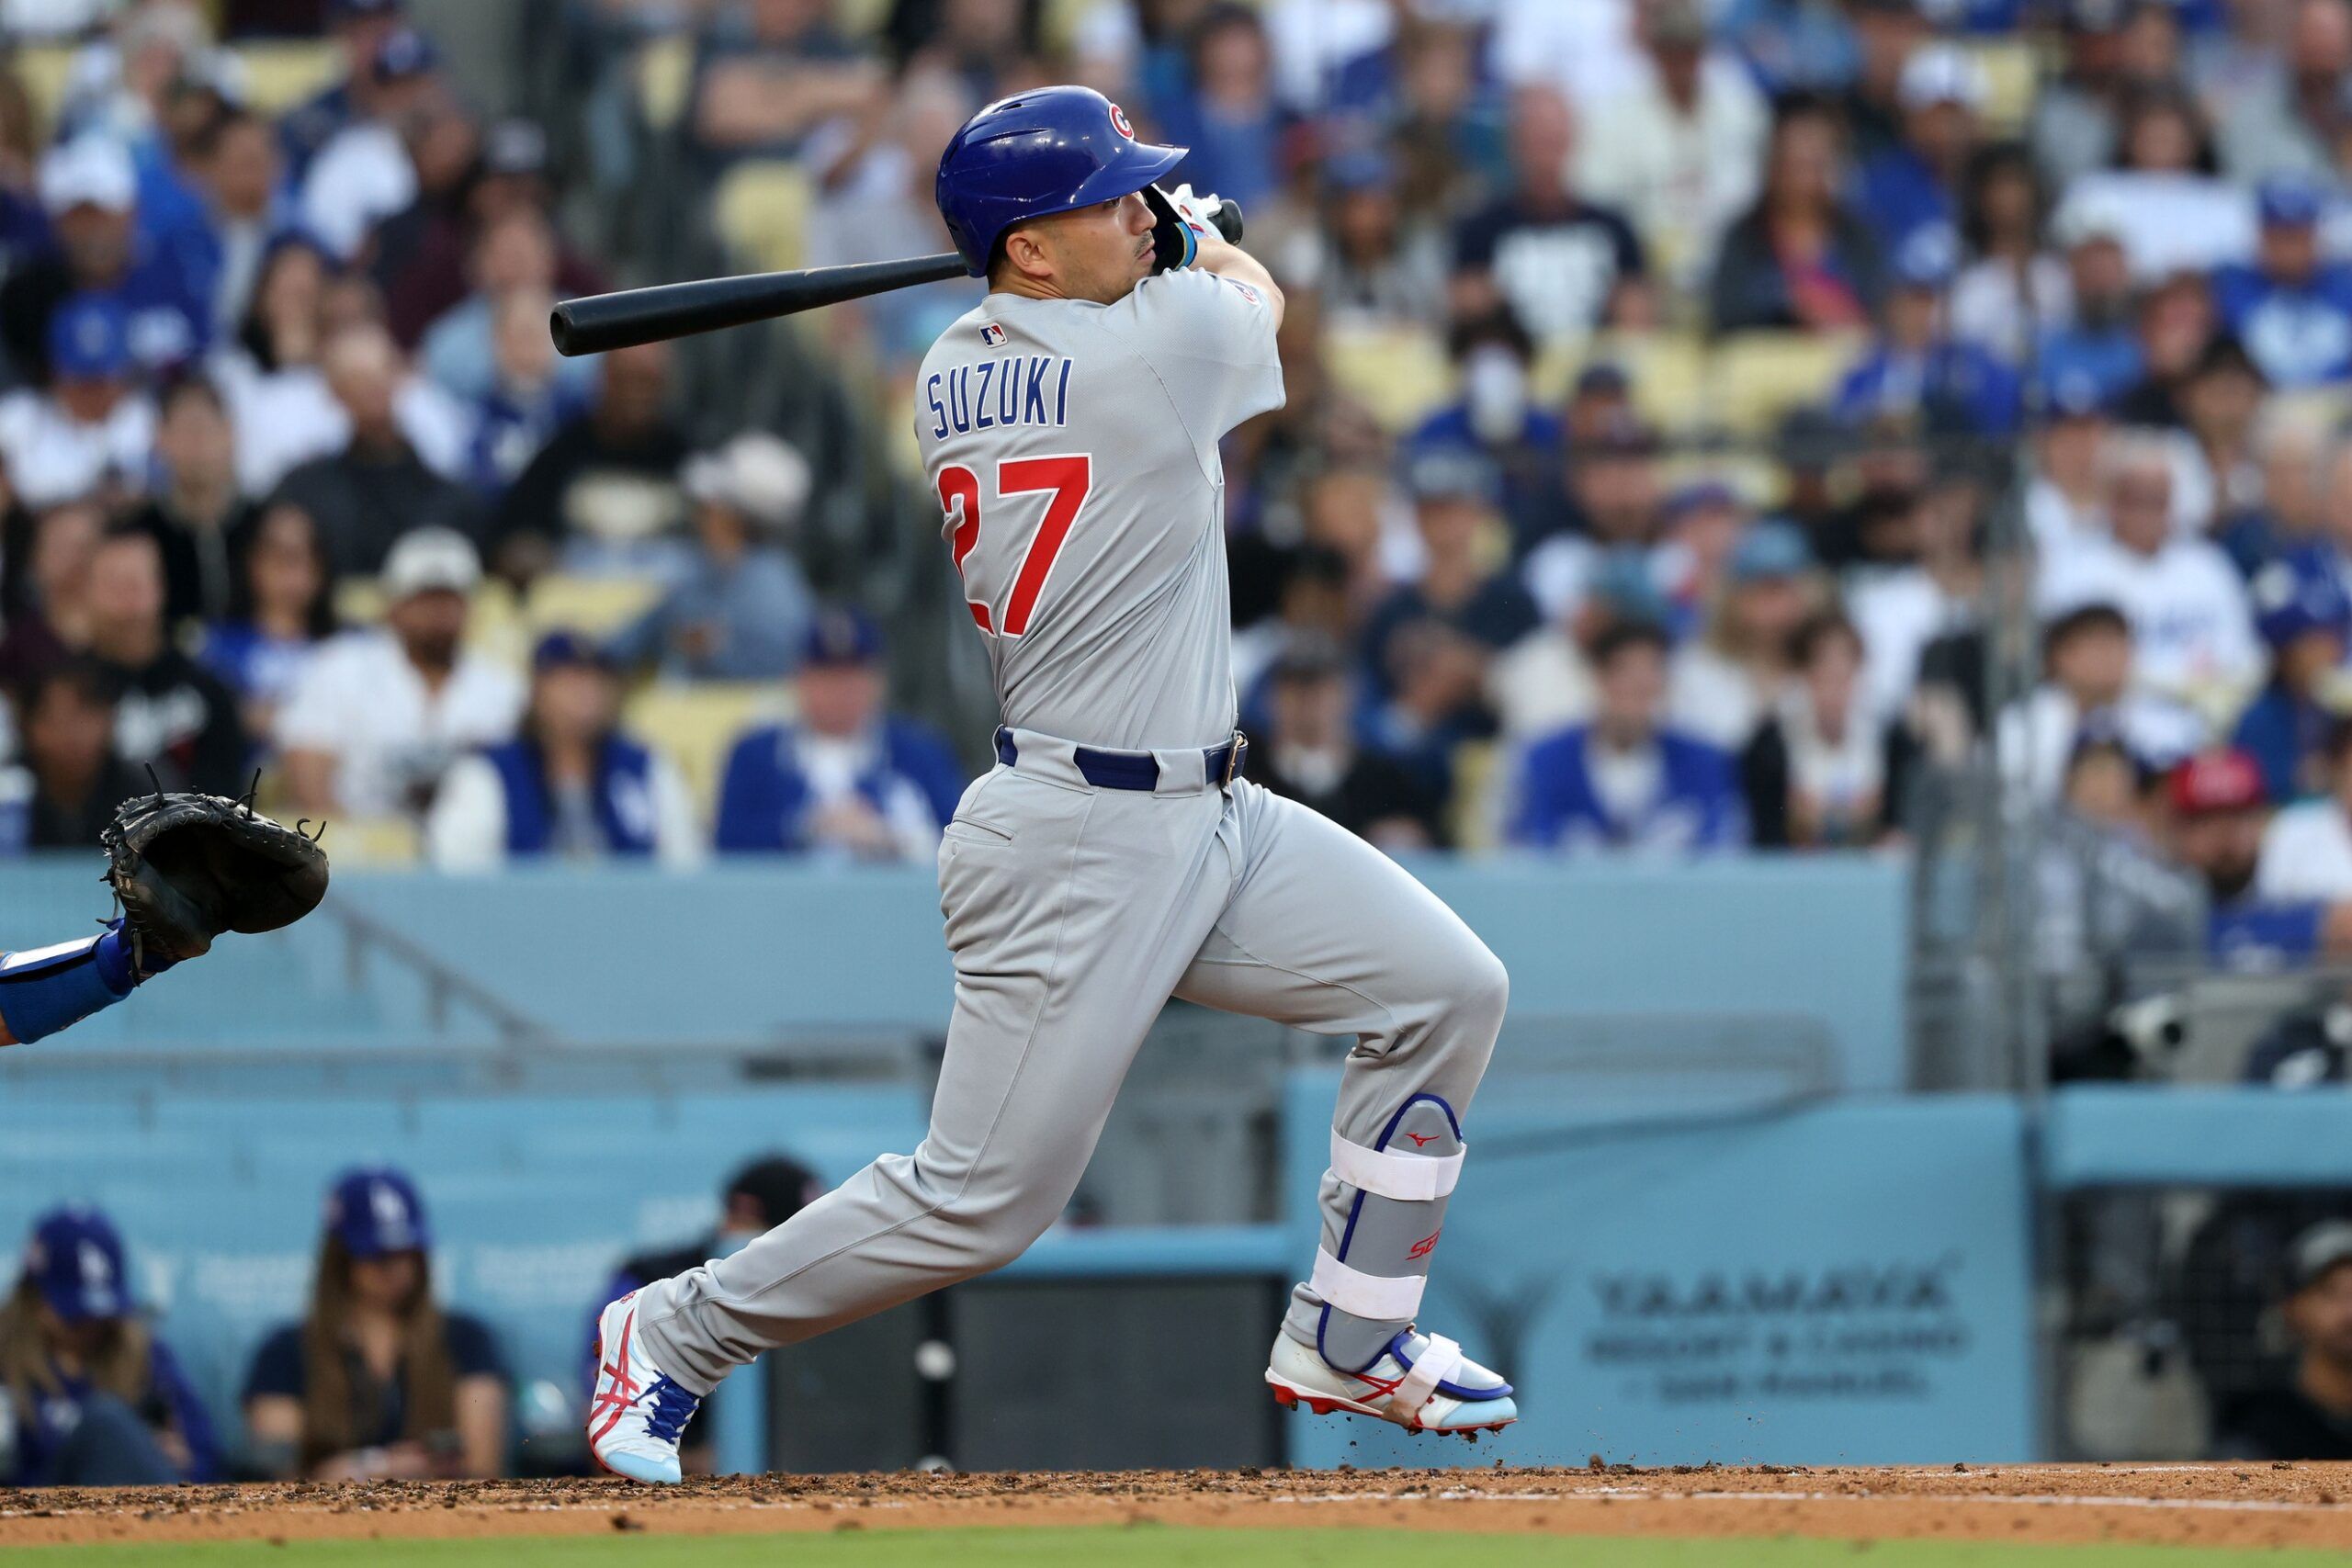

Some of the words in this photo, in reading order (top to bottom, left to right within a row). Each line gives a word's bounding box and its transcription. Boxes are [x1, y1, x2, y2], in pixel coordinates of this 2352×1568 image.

[1109, 103, 1135, 141] C
[927, 355, 1074, 442] SUZUKI
[937, 452, 1093, 638] 27
